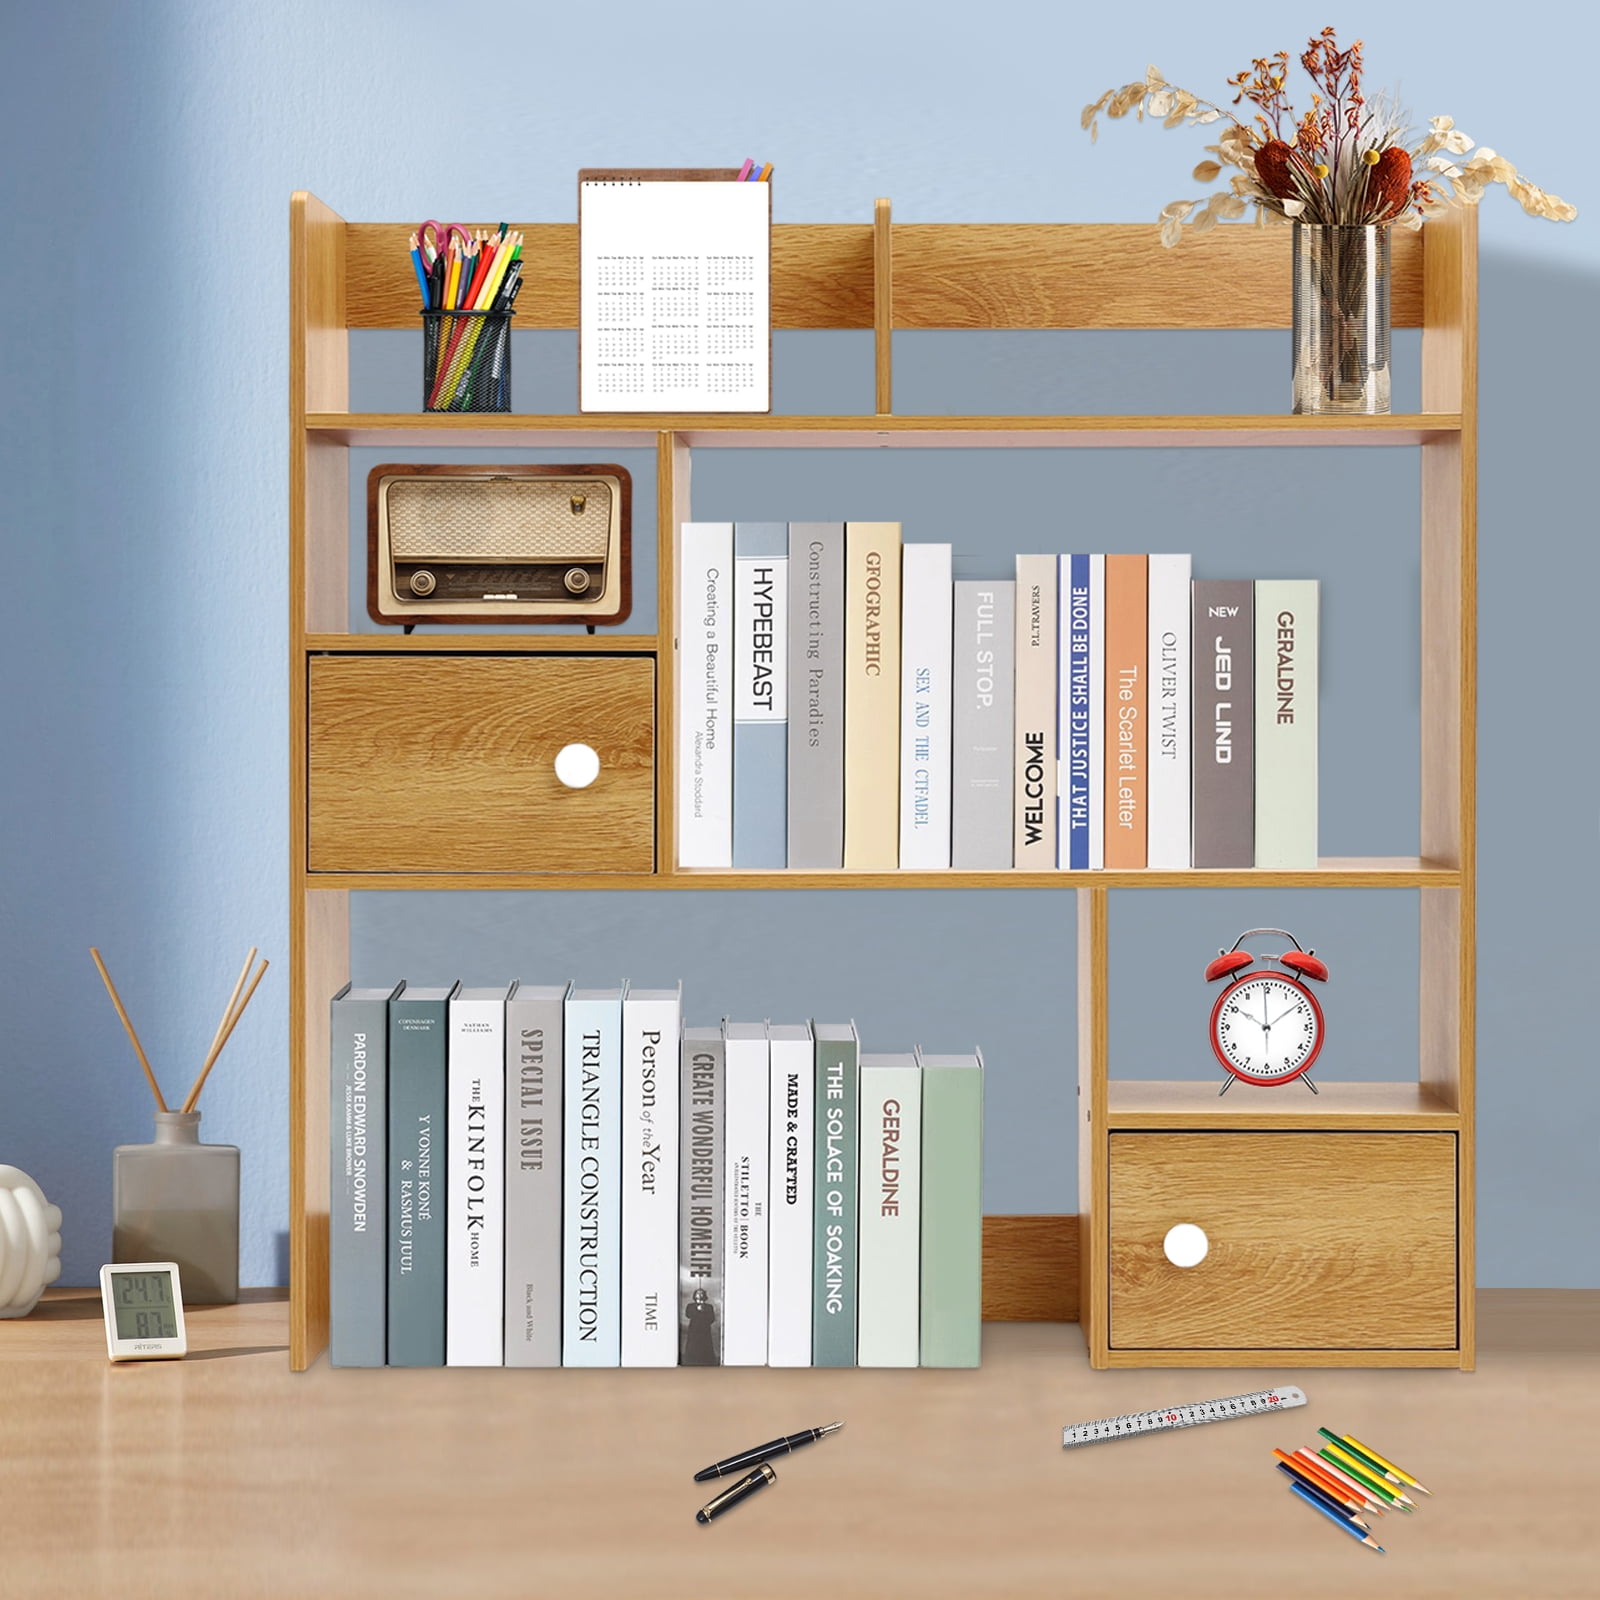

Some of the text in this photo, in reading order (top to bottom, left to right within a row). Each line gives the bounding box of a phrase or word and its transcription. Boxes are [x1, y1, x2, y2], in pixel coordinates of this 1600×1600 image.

[703, 568, 719, 626] Creating
[753, 569, 773, 711] HYPEBEAST
[807, 542, 823, 747] Constructing Paradies
[977, 592, 993, 709] FULL STOP.
[1209, 607, 1239, 617] NEW
[706, 644, 718, 703] Beautiful
[916, 668, 930, 693] SEX
[916, 702, 929, 727] AND
[1072, 587, 1087, 829] THAT JUSTICE SHALL BE DONE
[1162, 632, 1176, 759] OLIVER TWIST
[1216, 636, 1231, 763] JED LIND
[1277, 611, 1294, 724] GERALDINE
[694, 731, 703, 818] Alexandra Stoddard
[706, 709, 717, 749] Home
[915, 736, 929, 761] THE
[1119, 665, 1137, 829] The Scarlet Letter
[1025, 732, 1043, 845] WELCOME
[354, 1033, 366, 1231] PARDON EDWARD SNOWDEN
[419, 1128, 430, 1178] VONNE
[521, 1030, 543, 1170] SPECIAL ISSUE
[640, 1031, 660, 1194] Person of the Year
[786, 1074, 798, 1205] MADE & CRAFTED
[882, 1099, 900, 1216] GERALDINE
[399, 1160, 412, 1274] & RASMUS JUUL
[419, 1181, 431, 1220] KONÉ
[468, 1079, 484, 1266] THE KINFOLK HOME
[580, 1030, 600, 1341] TRIANGLE CONSTRUCTION
[690, 1054, 715, 1277] CREATE WONDERFUL HOMELIFE
[739, 1156, 750, 1260] STILETTO BOOK
[826, 1062, 843, 1314] THE SOLACE OF SOAKING
[645, 1293, 657, 1330] TIME
